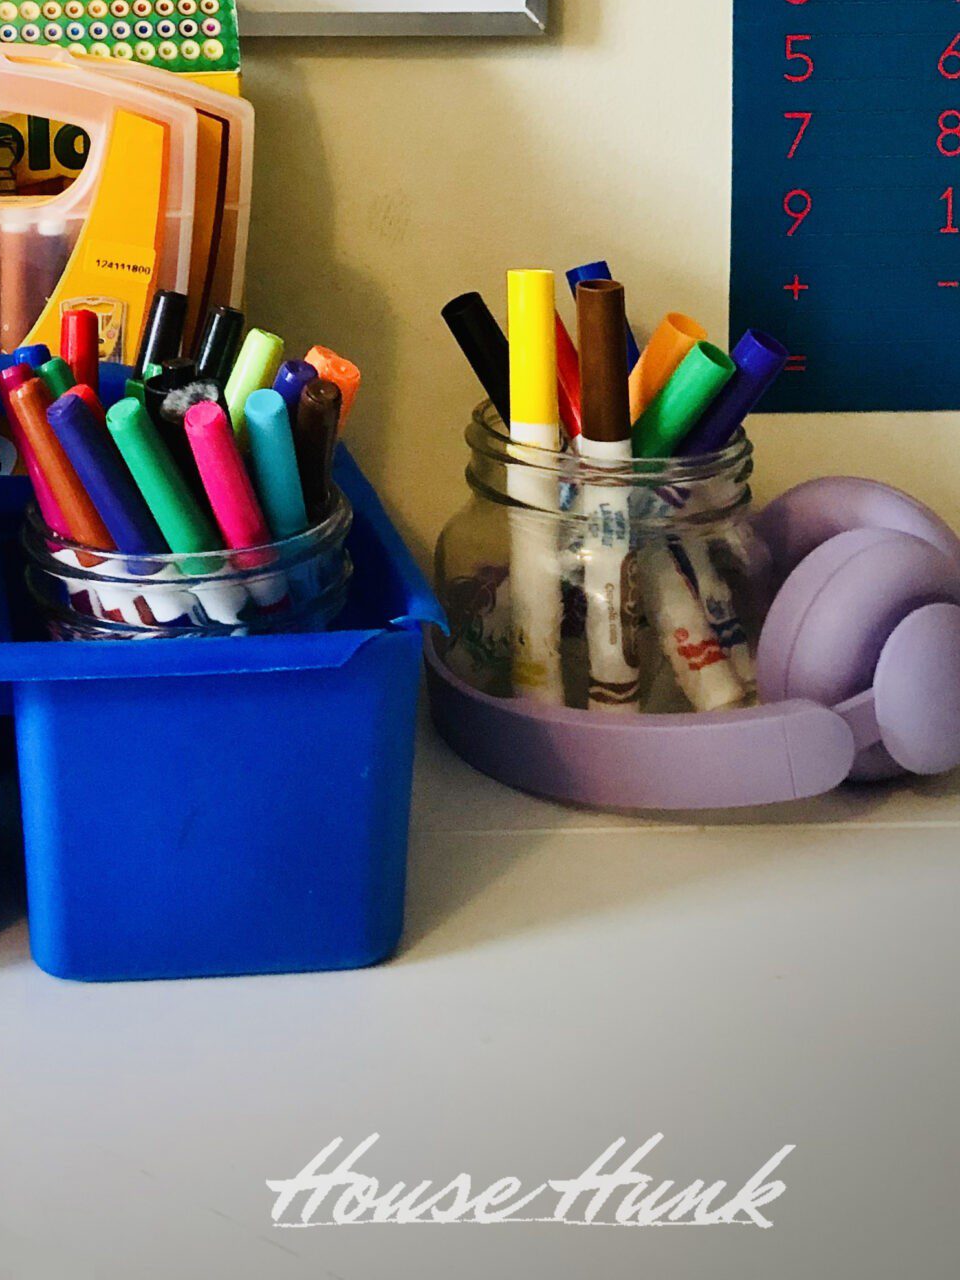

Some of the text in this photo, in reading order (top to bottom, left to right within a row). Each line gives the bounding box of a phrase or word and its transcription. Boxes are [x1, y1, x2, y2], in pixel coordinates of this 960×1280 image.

[784, 34, 814, 83] 5
[784, 112, 812, 158] 7
[783, 189, 813, 236] 9
